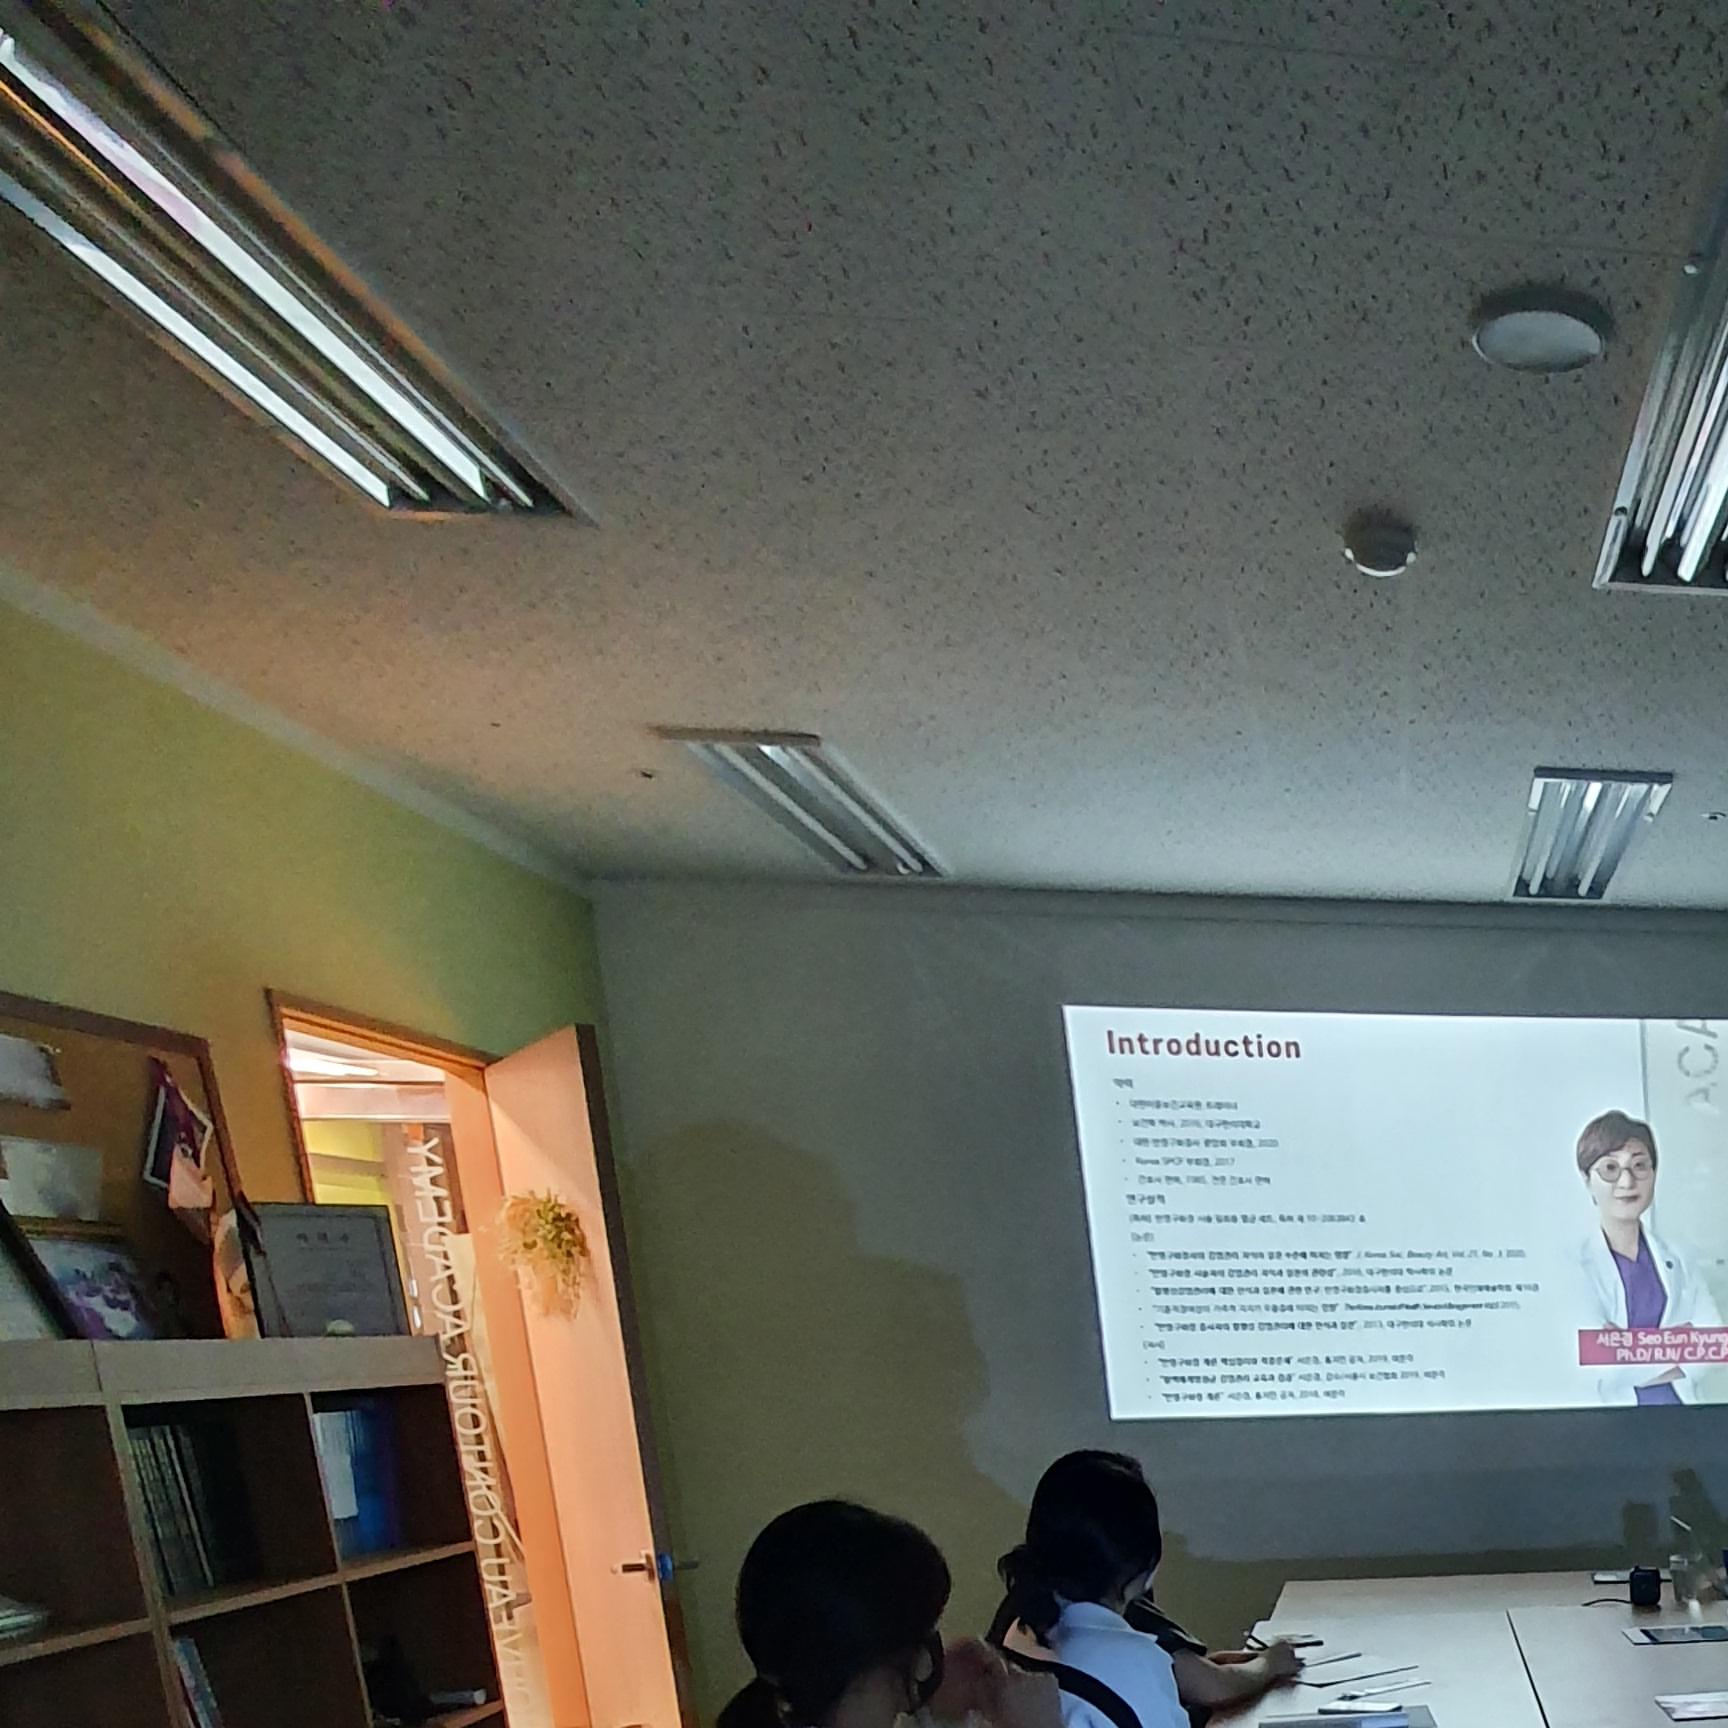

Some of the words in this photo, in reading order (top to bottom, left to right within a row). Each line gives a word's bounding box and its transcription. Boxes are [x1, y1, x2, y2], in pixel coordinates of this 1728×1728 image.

[1107, 1030, 1302, 1059] Introduction
[1637, 1332, 1662, 1345] Seo
[1664, 1332, 1689, 1345] Eun
